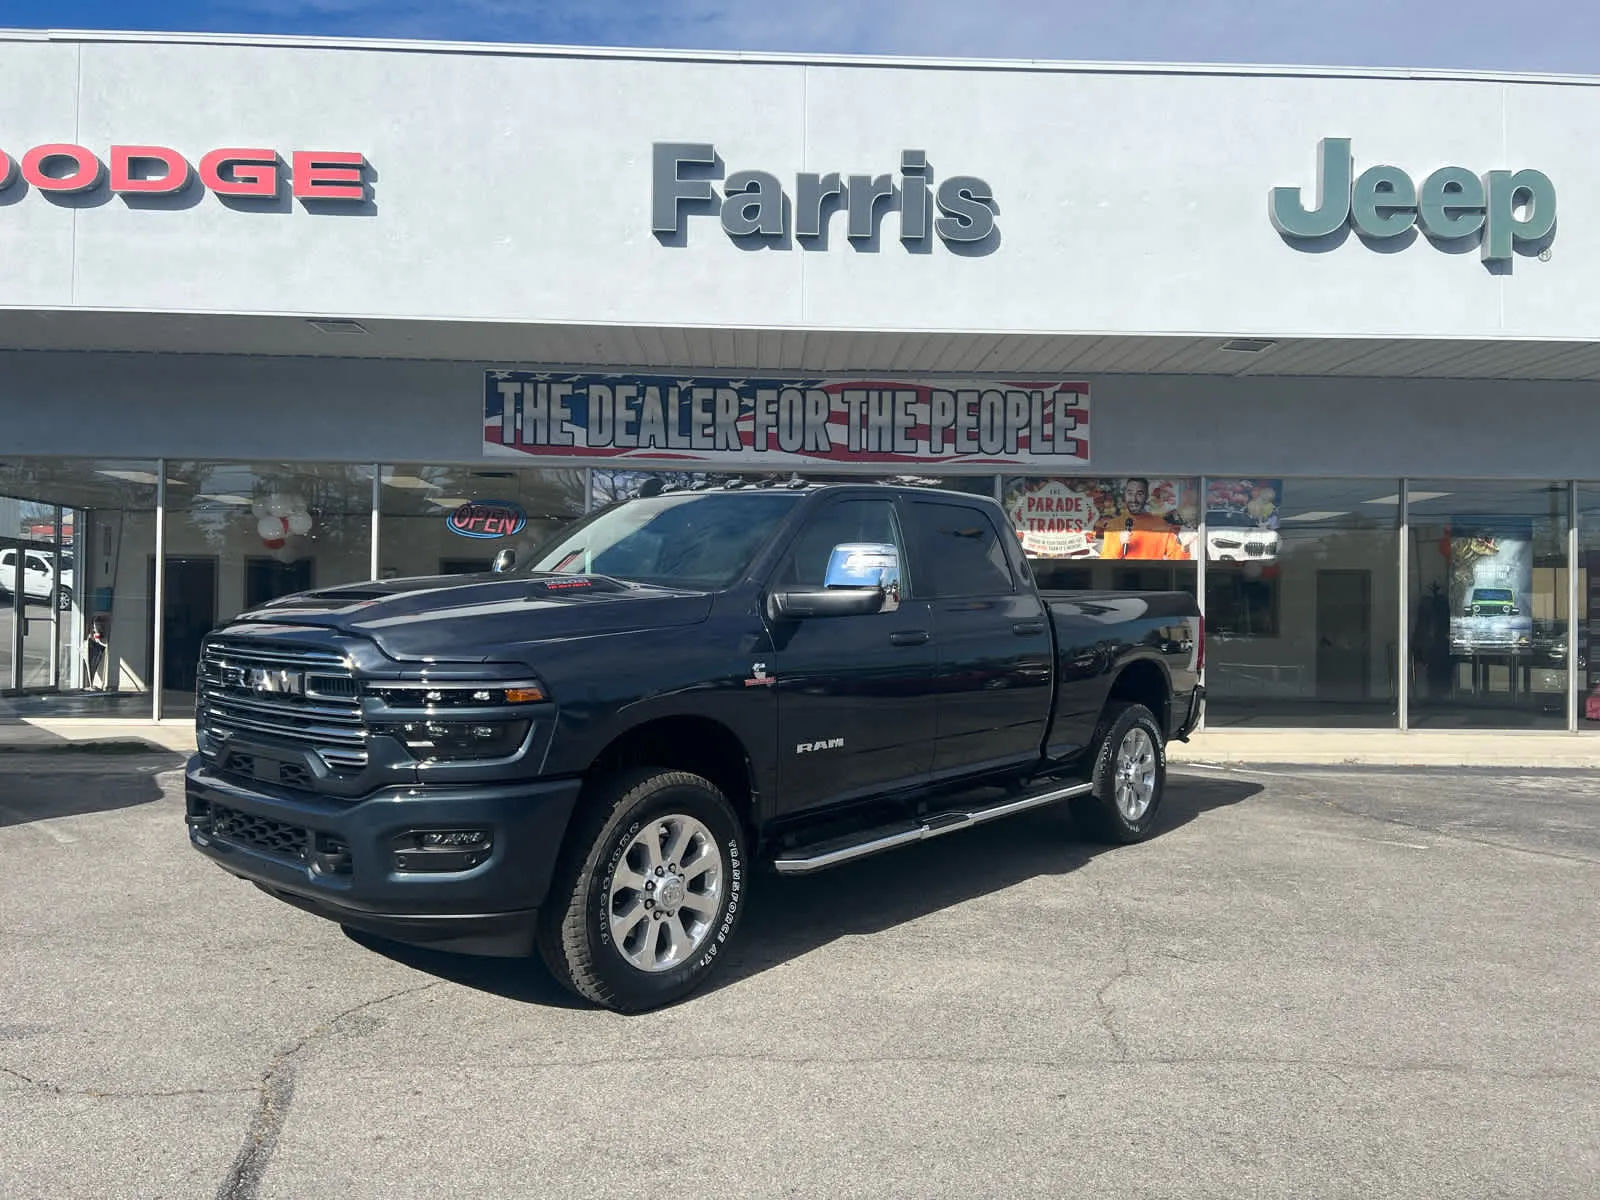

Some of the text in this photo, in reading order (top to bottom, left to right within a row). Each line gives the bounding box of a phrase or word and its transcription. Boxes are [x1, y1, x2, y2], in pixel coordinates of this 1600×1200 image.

[0, 143, 365, 200] ODGE
[651, 142, 995, 243] Farris
[1268, 137, 1557, 262] Jeep
[498, 381, 1079, 455] THE DEALER FOR THE PEOPLE
[453, 503, 518, 536] OPEN
[1027, 496, 1083, 513] PARADE
[1026, 518, 1083, 533] TRADES
[220, 665, 304, 694] RAM
[796, 738, 845, 754] RAM
